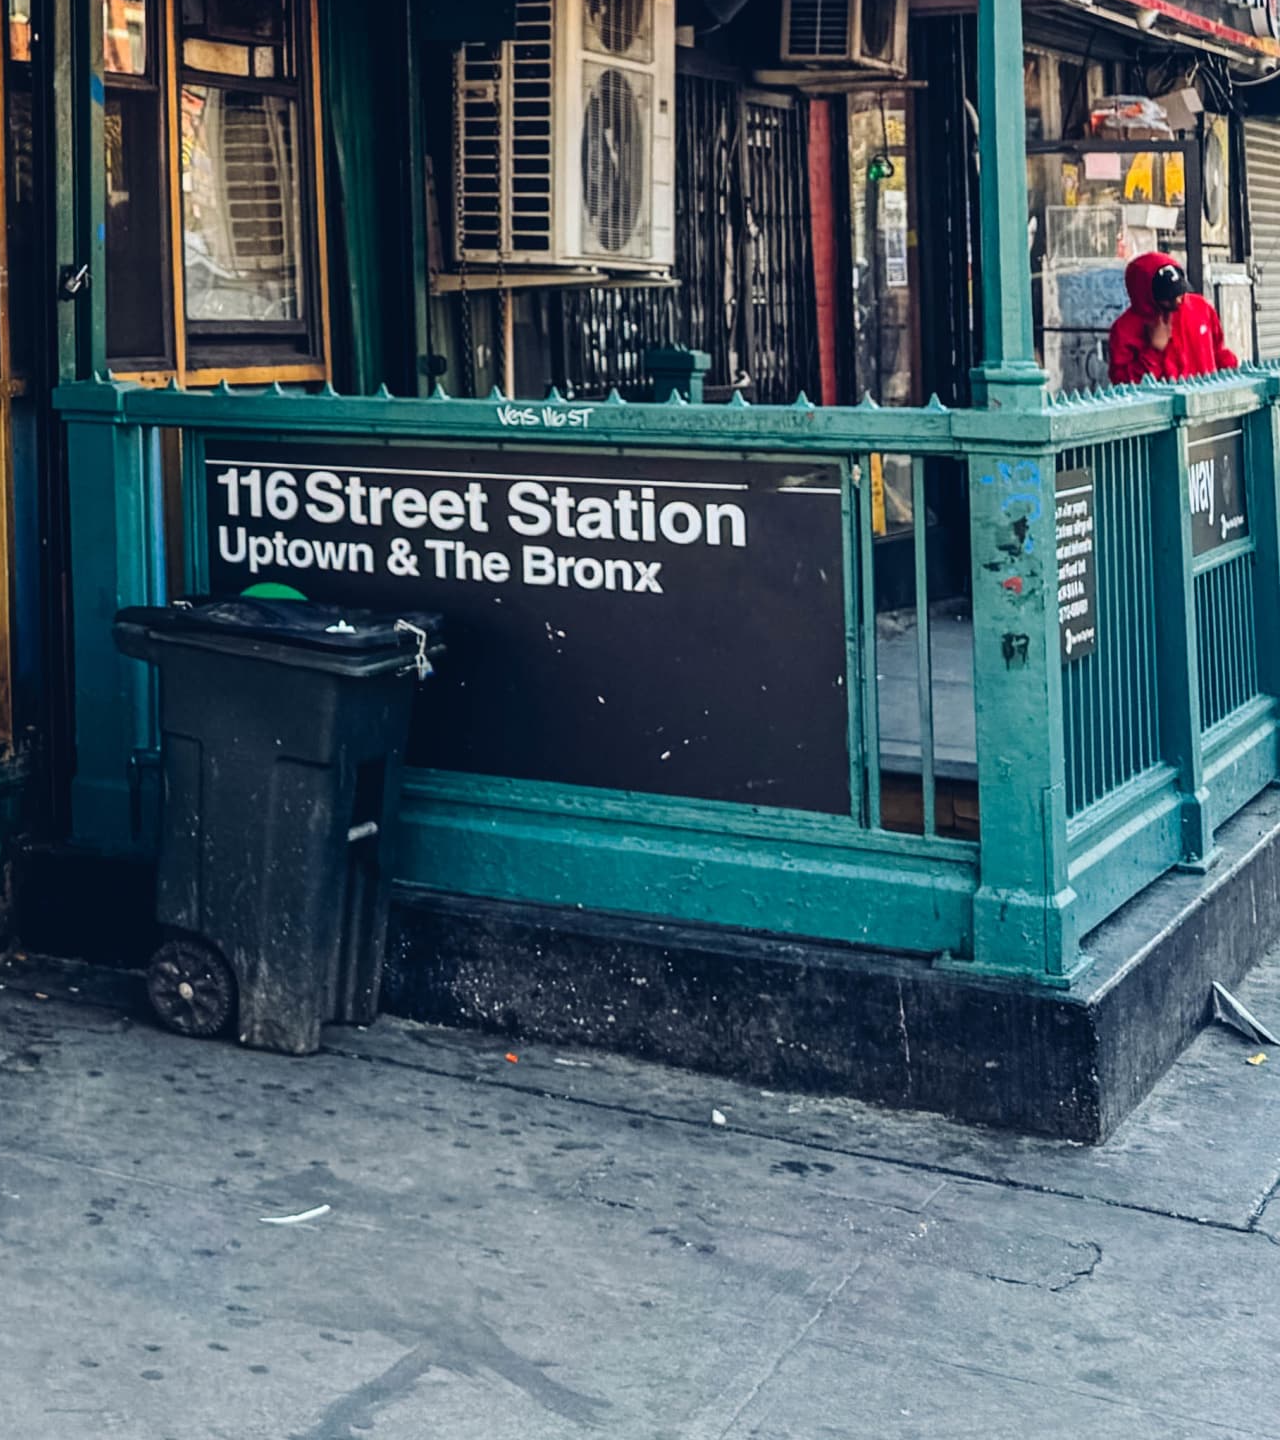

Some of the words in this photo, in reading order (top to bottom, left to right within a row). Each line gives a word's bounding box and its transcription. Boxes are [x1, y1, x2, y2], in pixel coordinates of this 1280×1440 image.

[217, 467, 298, 521] 116
[305, 471, 488, 533] Street
[508, 480, 747, 547] Station
[219, 526, 374, 582] Uptown
[388, 539, 420, 578] &
[425, 539, 510, 582] The
[522, 545, 664, 594] Bronx
